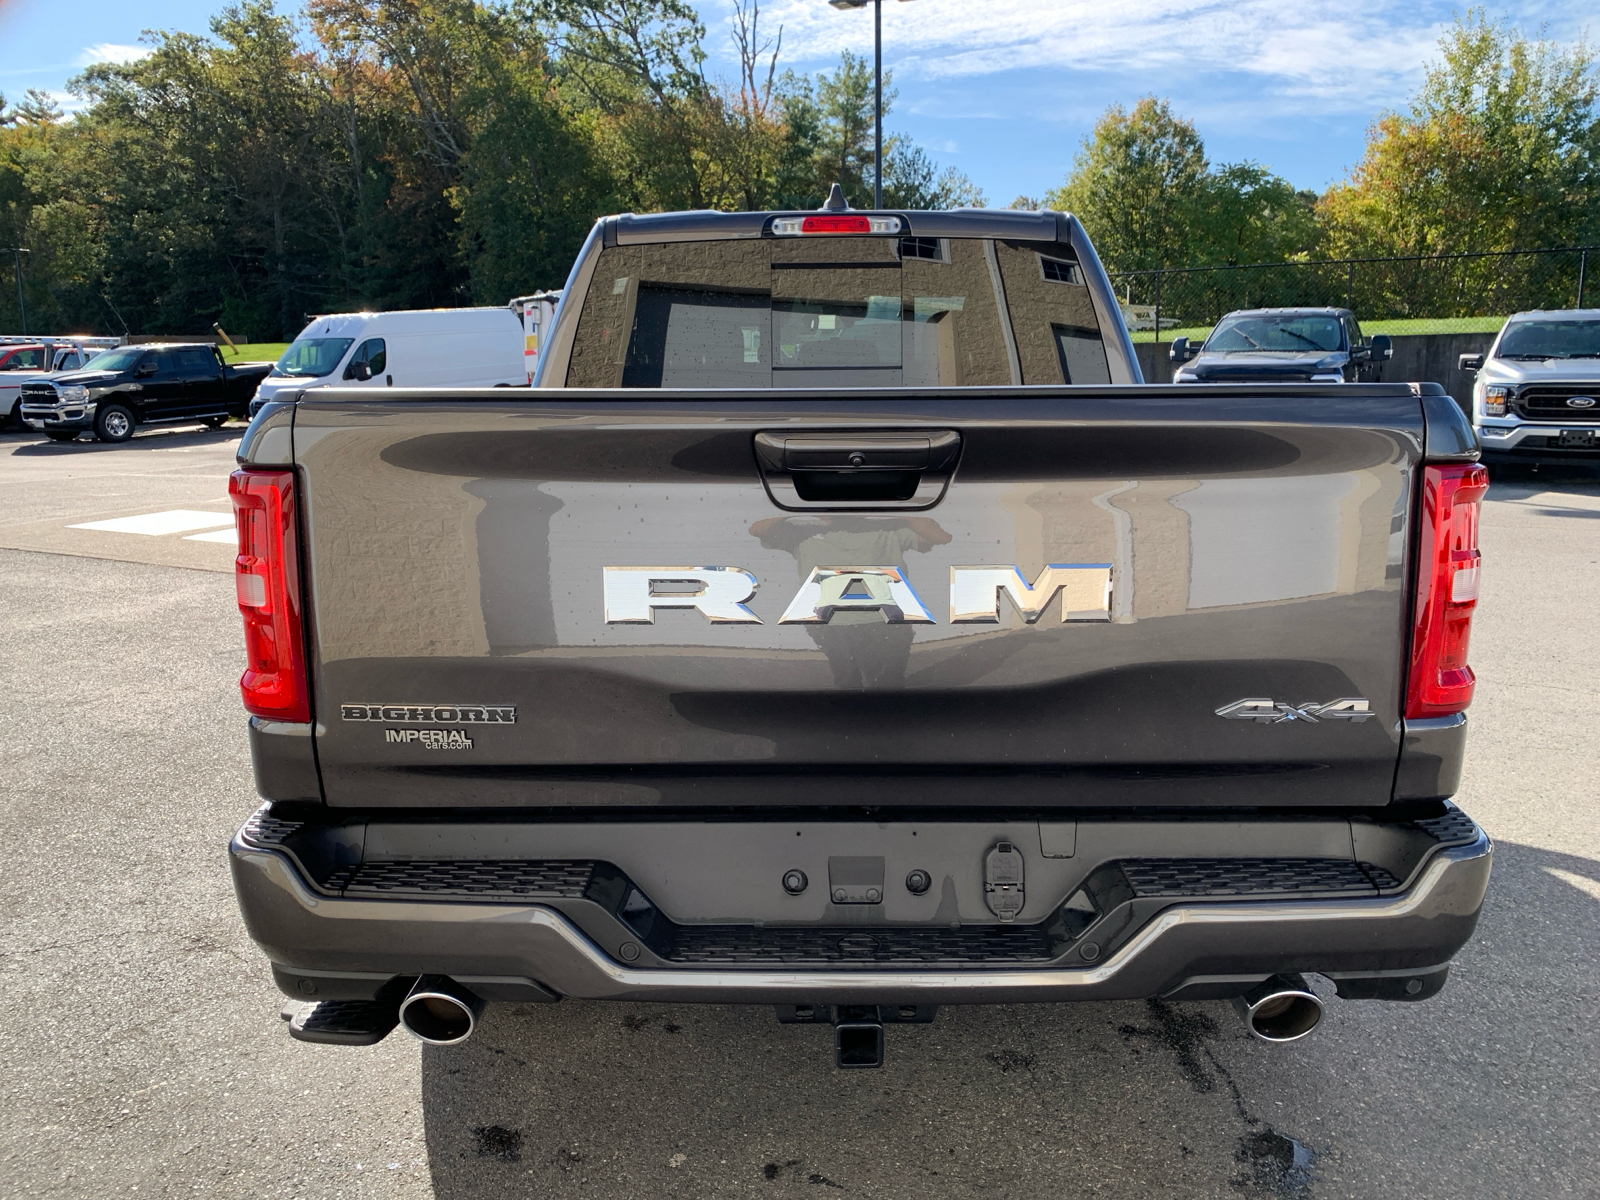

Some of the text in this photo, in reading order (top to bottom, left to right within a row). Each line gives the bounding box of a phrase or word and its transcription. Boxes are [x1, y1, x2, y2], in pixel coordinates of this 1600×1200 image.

[602, 564, 1113, 624] RAM
[340, 703, 518, 724] BIGHORN
[385, 729, 473, 742] IMPERIAL
[425, 740, 474, 750] cars.com
